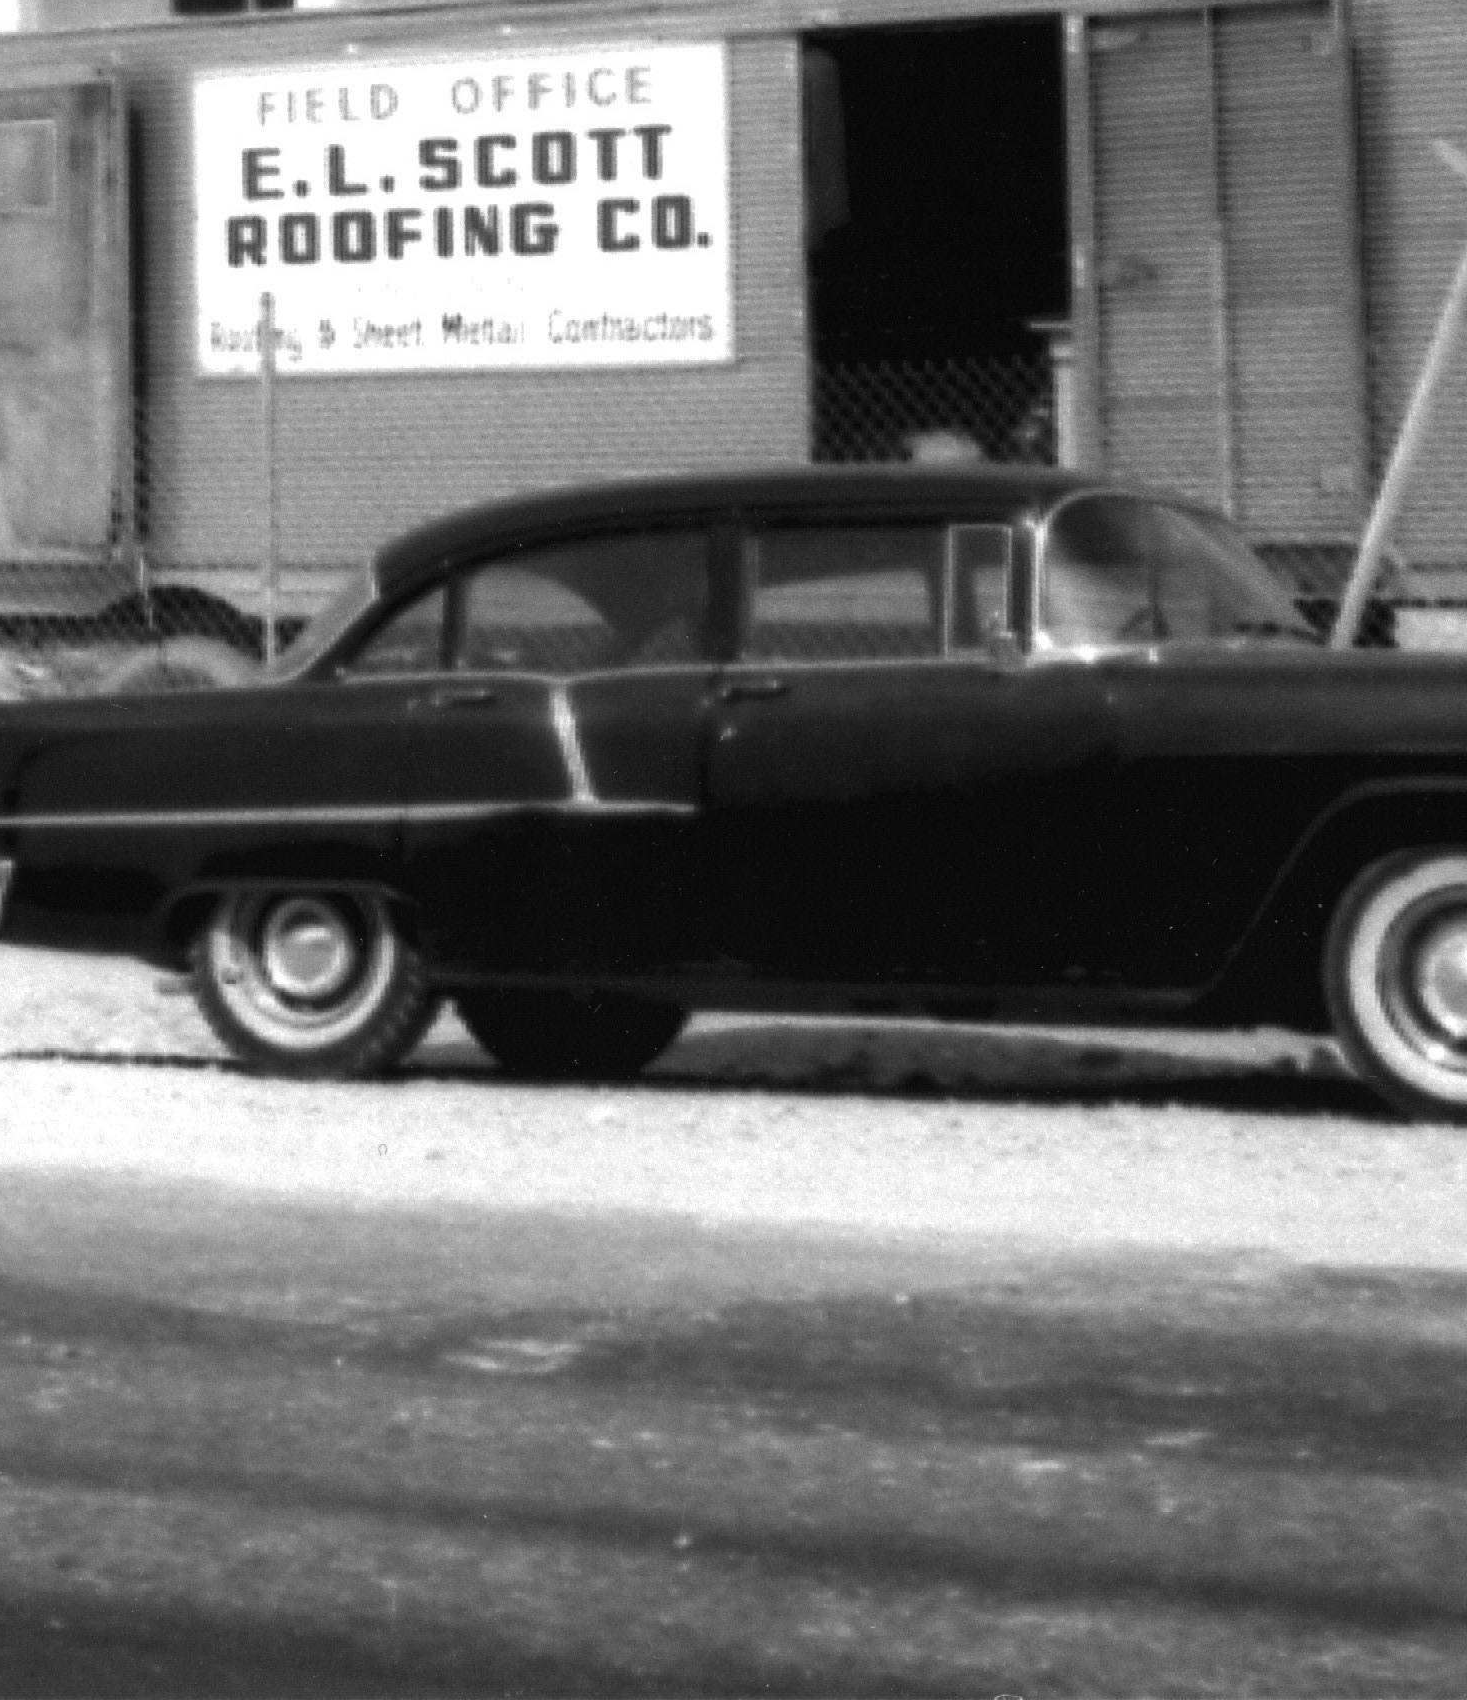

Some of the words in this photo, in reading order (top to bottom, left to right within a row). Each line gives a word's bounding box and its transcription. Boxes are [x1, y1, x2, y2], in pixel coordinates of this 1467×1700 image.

[257, 83, 398, 126] FIELD
[451, 66, 652, 115] OFFICE
[417, 124, 672, 192] SCOTT
[225, 203, 560, 268] ROOFING
[596, 194, 713, 253] CO.
